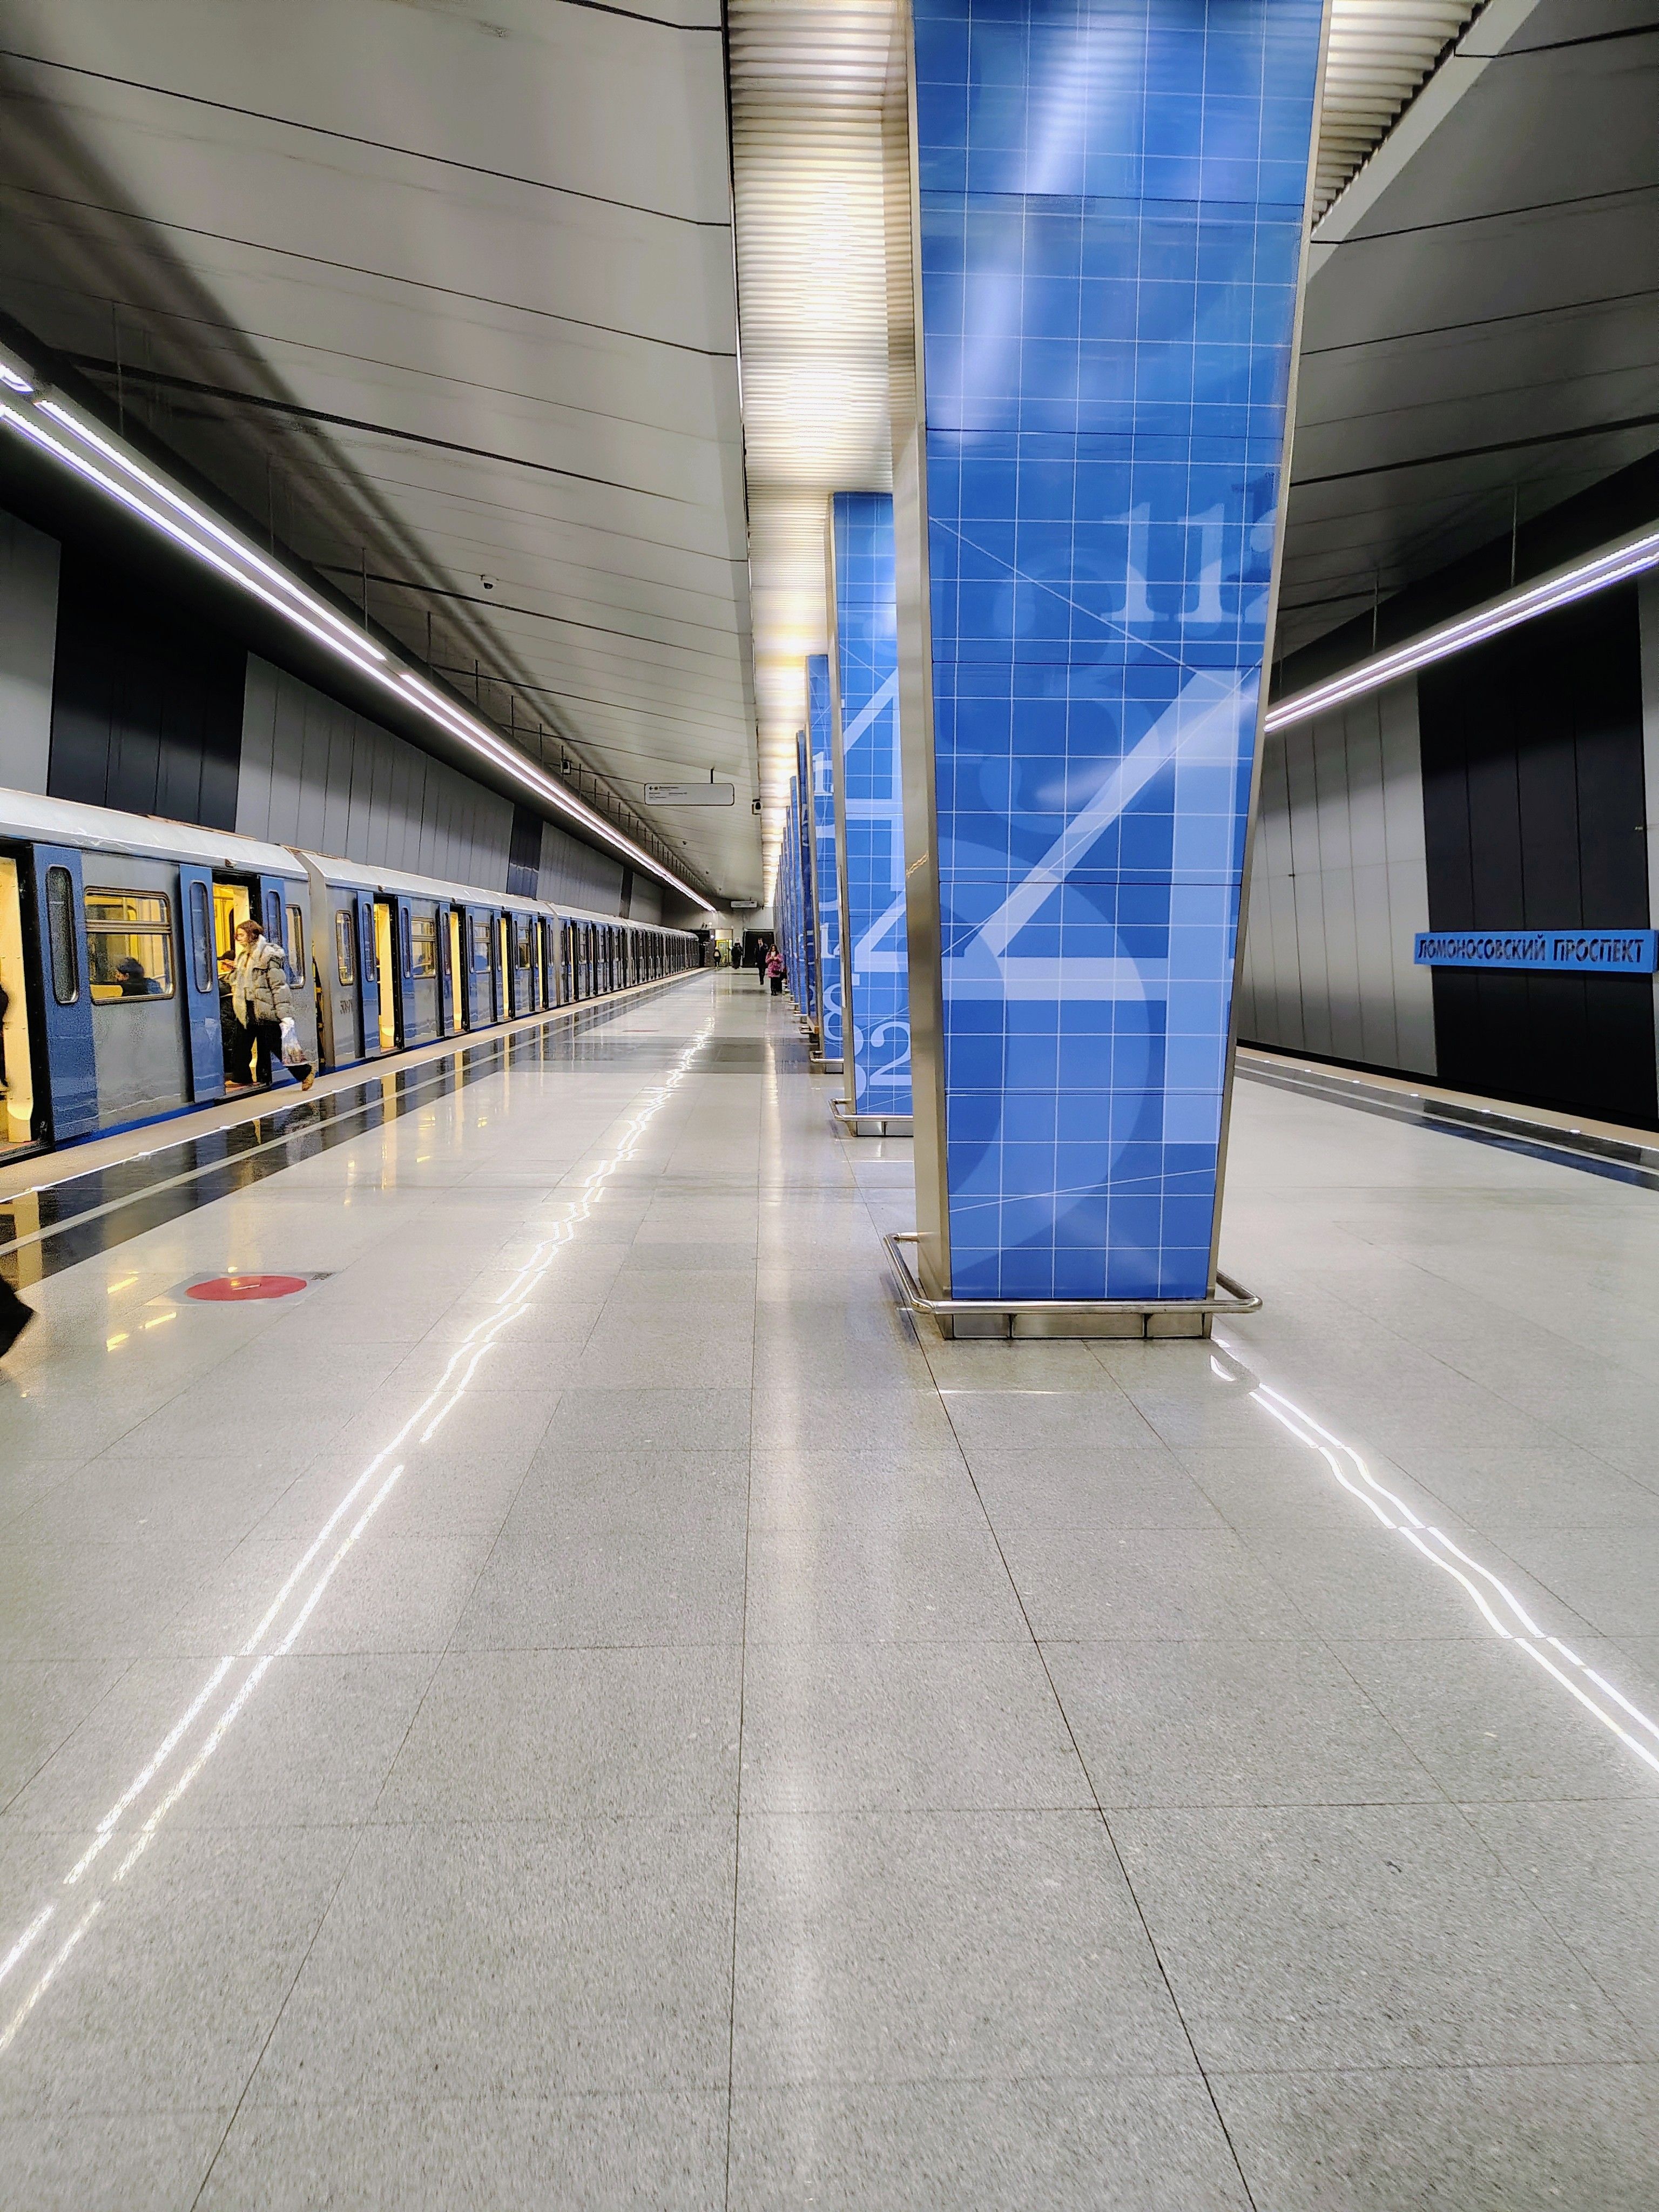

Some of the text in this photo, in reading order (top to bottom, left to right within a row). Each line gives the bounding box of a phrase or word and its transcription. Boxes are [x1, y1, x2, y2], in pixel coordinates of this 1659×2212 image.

[941, 670, 1242, 1144] 4
[1418, 934, 1644, 962] ЛОМОНОСОВСКИЙ ПРОСПЕКТ
